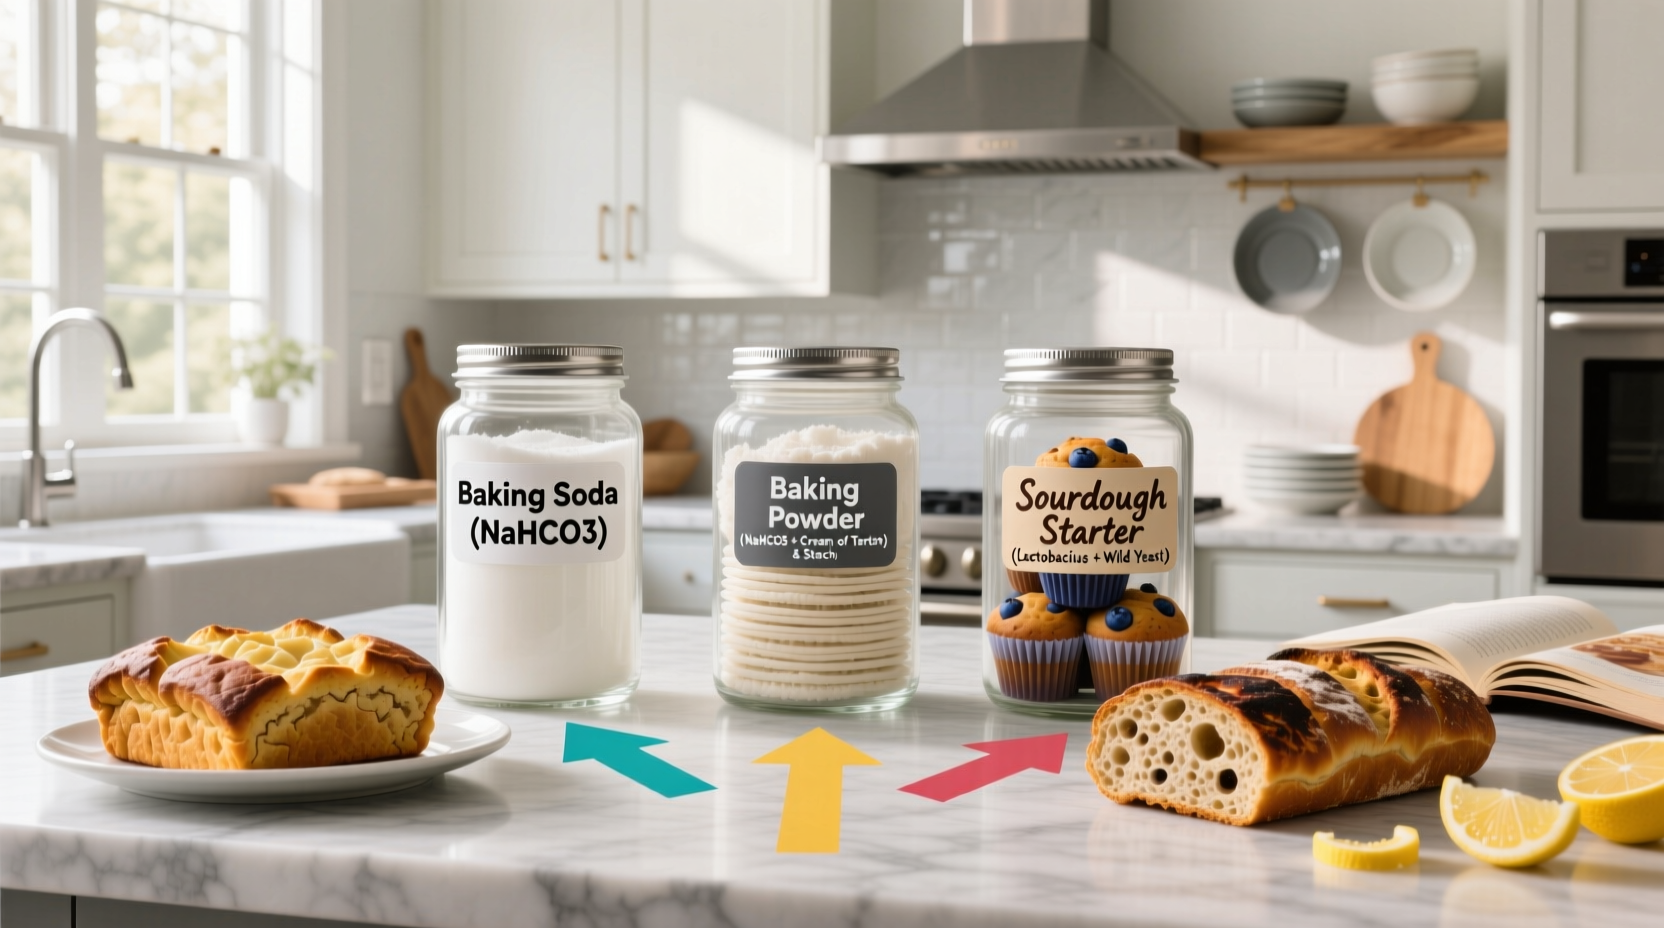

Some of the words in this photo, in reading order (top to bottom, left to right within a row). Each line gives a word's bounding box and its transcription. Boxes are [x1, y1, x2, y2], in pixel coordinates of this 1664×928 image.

[458, 480, 545, 514] Baking
[553, 480, 618, 507] Soda
[770, 475, 859, 507] Baking
[1015, 477, 1167, 522] Sourdough
[470, 515, 608, 551] (NaHCO3)
[768, 505, 865, 530] Powder
[1039, 513, 1145, 545] Starter
[837, 535, 849, 546] of
[1093, 553, 1102, 563] +
[1103, 549, 1131, 564] Wild
[1134, 547, 1170, 565] Yeast)
